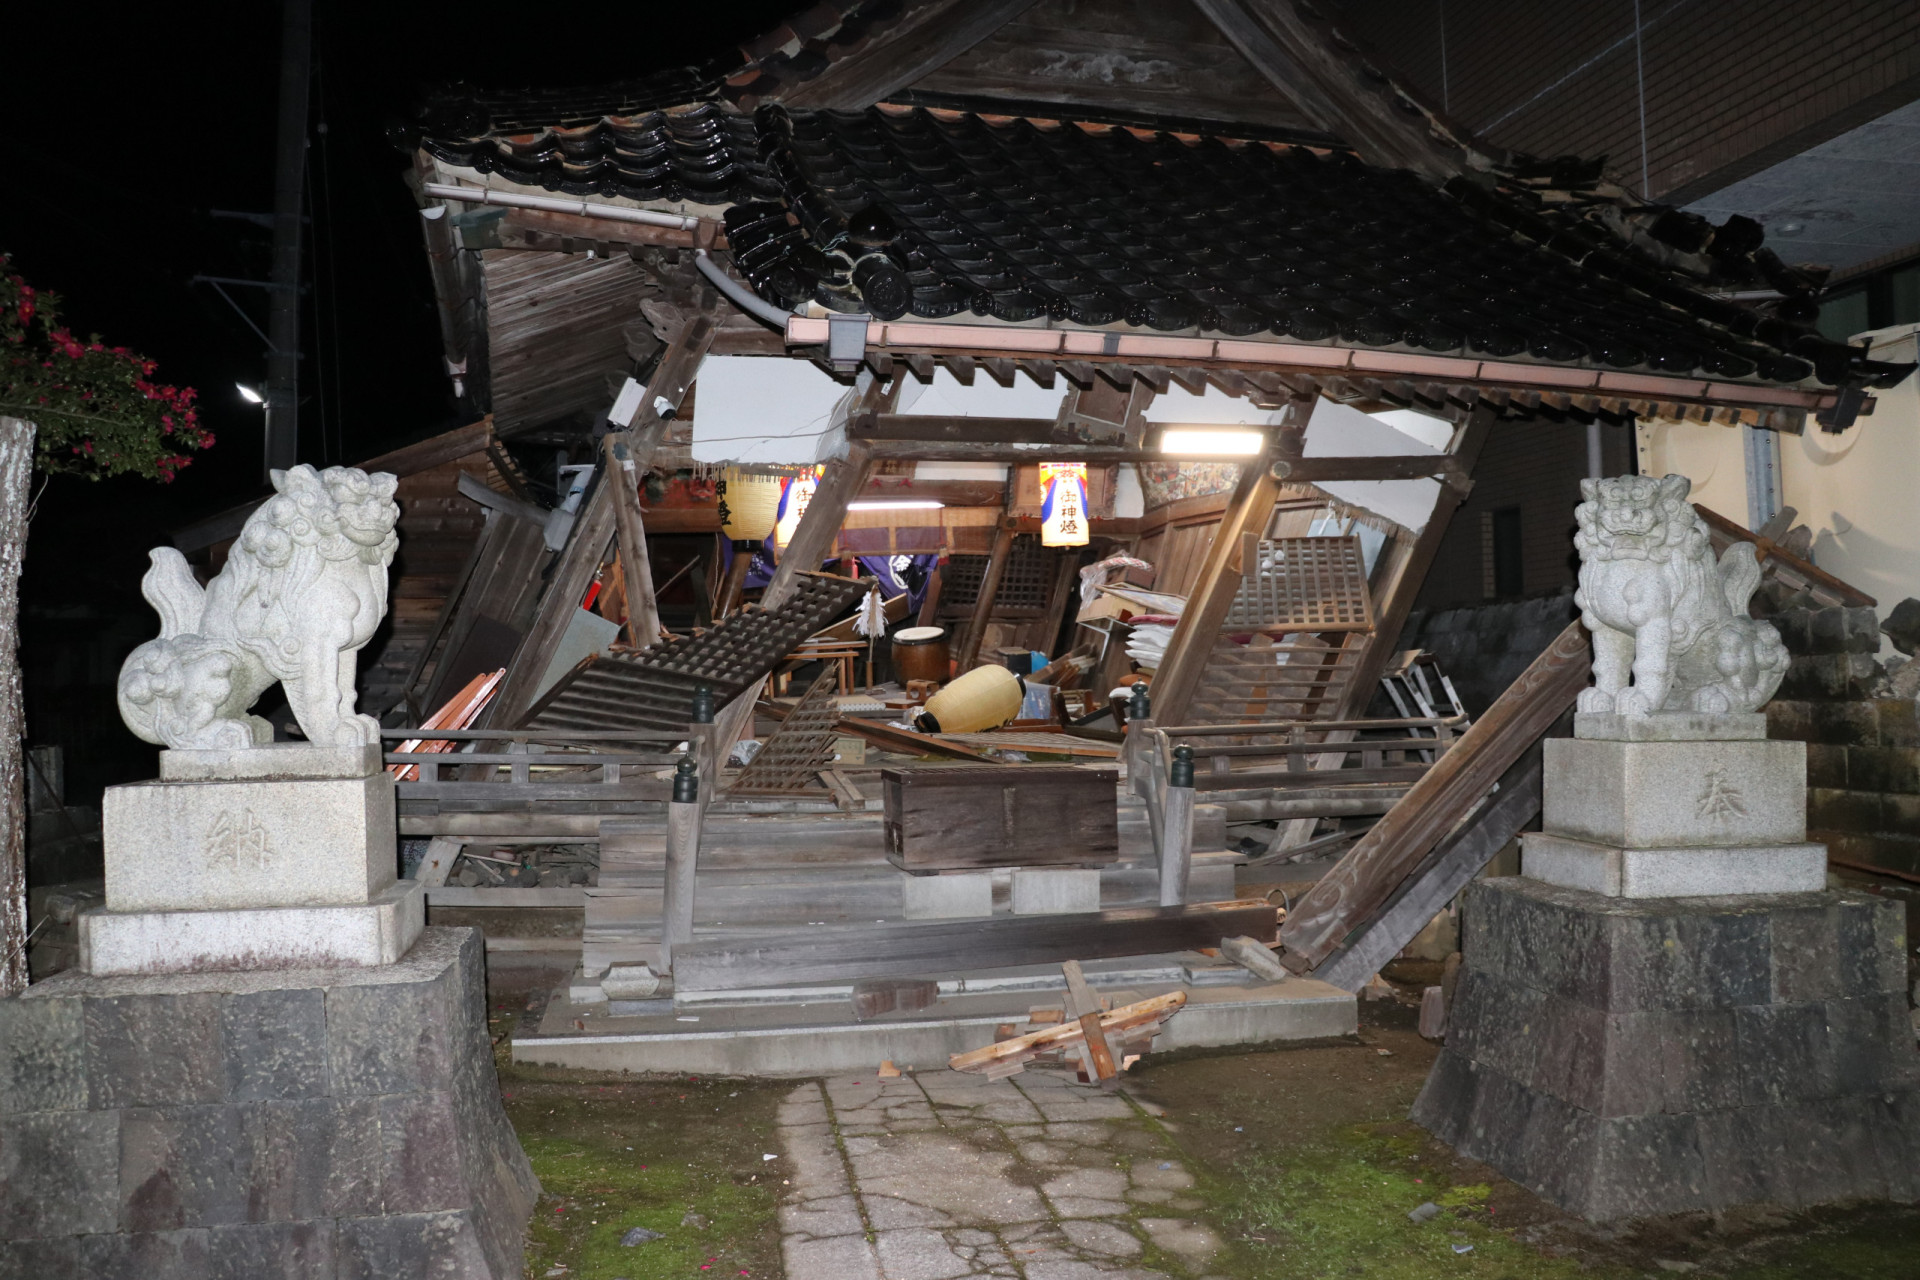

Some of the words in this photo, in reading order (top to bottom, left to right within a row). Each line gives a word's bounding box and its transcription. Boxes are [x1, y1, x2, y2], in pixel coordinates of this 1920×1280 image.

[1060, 489, 1078, 535] 御神燈
[1695, 759, 1748, 823] 奉
[205, 807, 277, 871] 納
